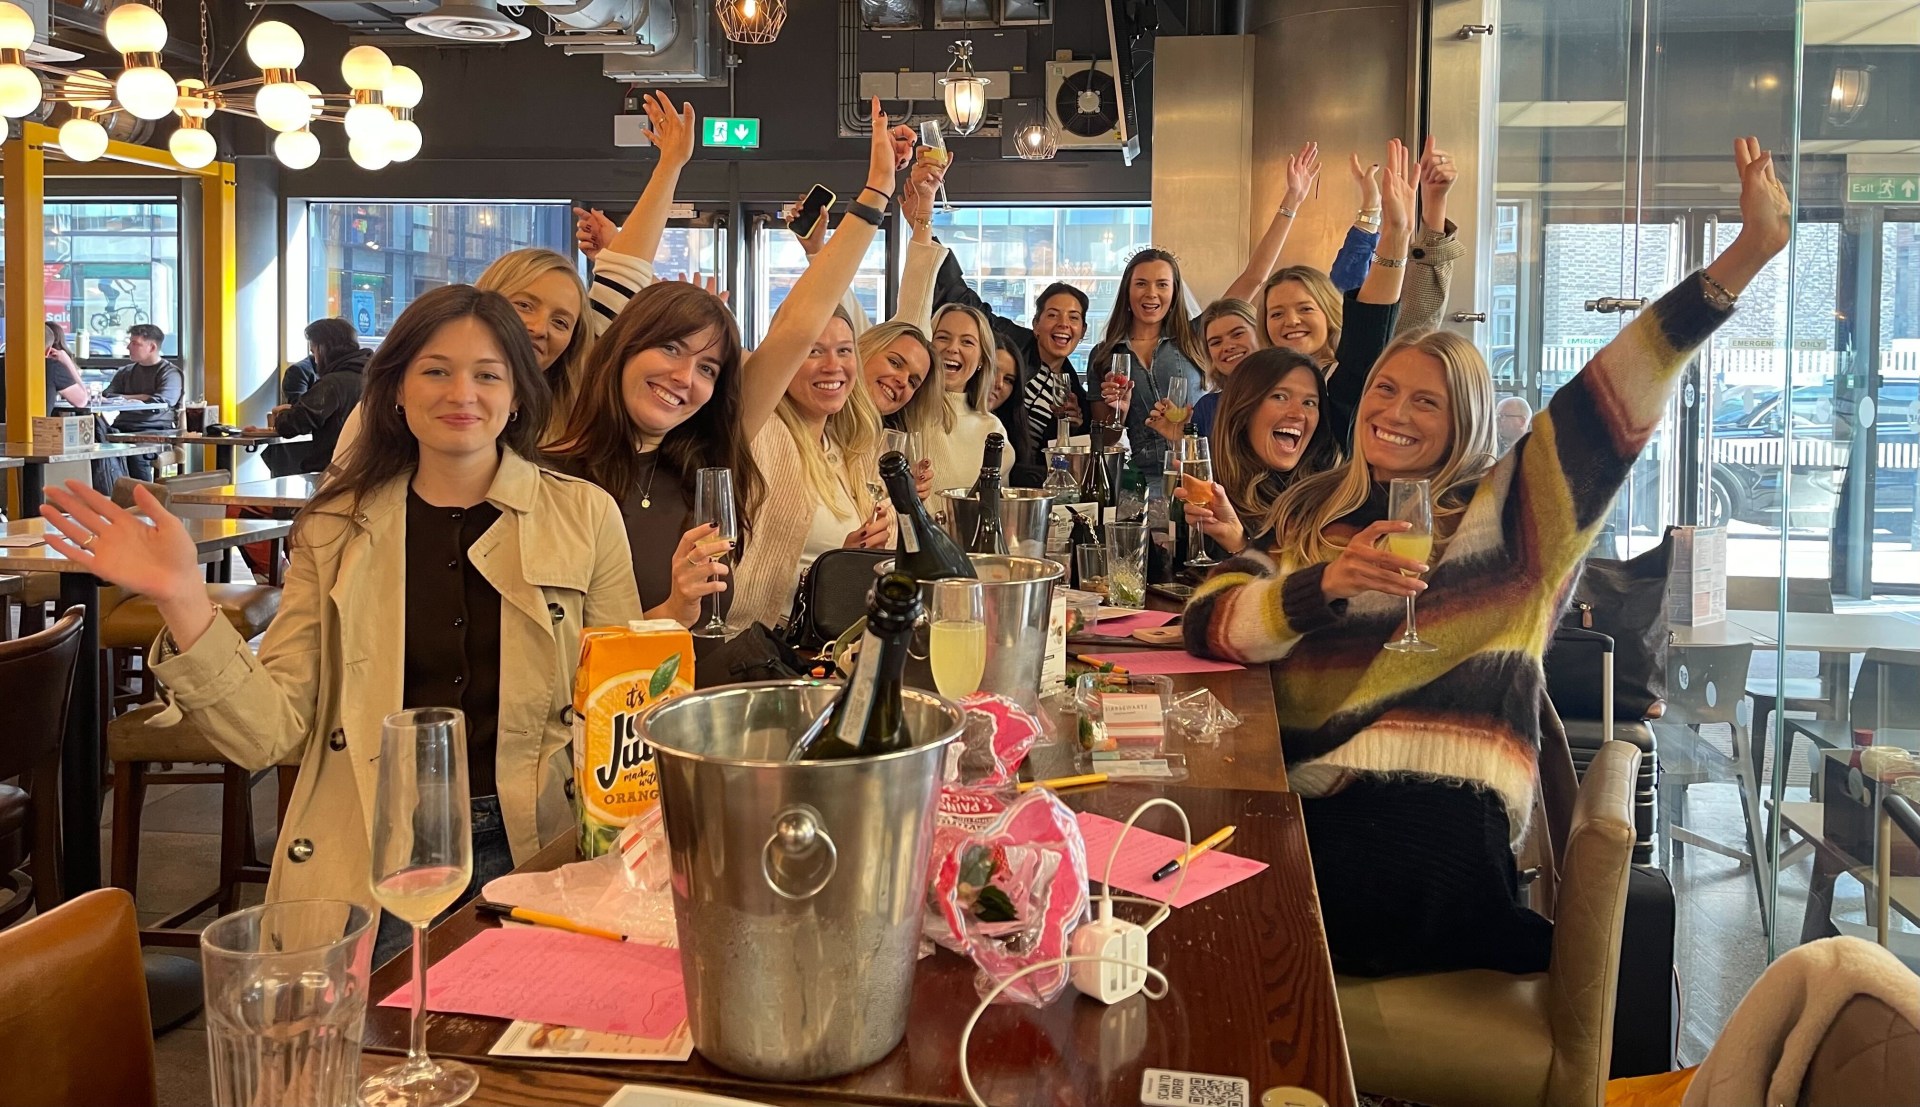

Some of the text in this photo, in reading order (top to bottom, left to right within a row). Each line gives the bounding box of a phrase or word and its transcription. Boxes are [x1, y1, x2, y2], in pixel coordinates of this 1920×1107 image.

[1853, 184, 1874, 193] Exit
[1123, 245, 1150, 263] BRIDE
[626, 683, 646, 708] it's
[624, 767, 648, 782] made
[604, 789, 659, 805] ORANG
[1158, 1083, 1170, 1100] SCAN
[1172, 1078, 1184, 1099] ORDER
